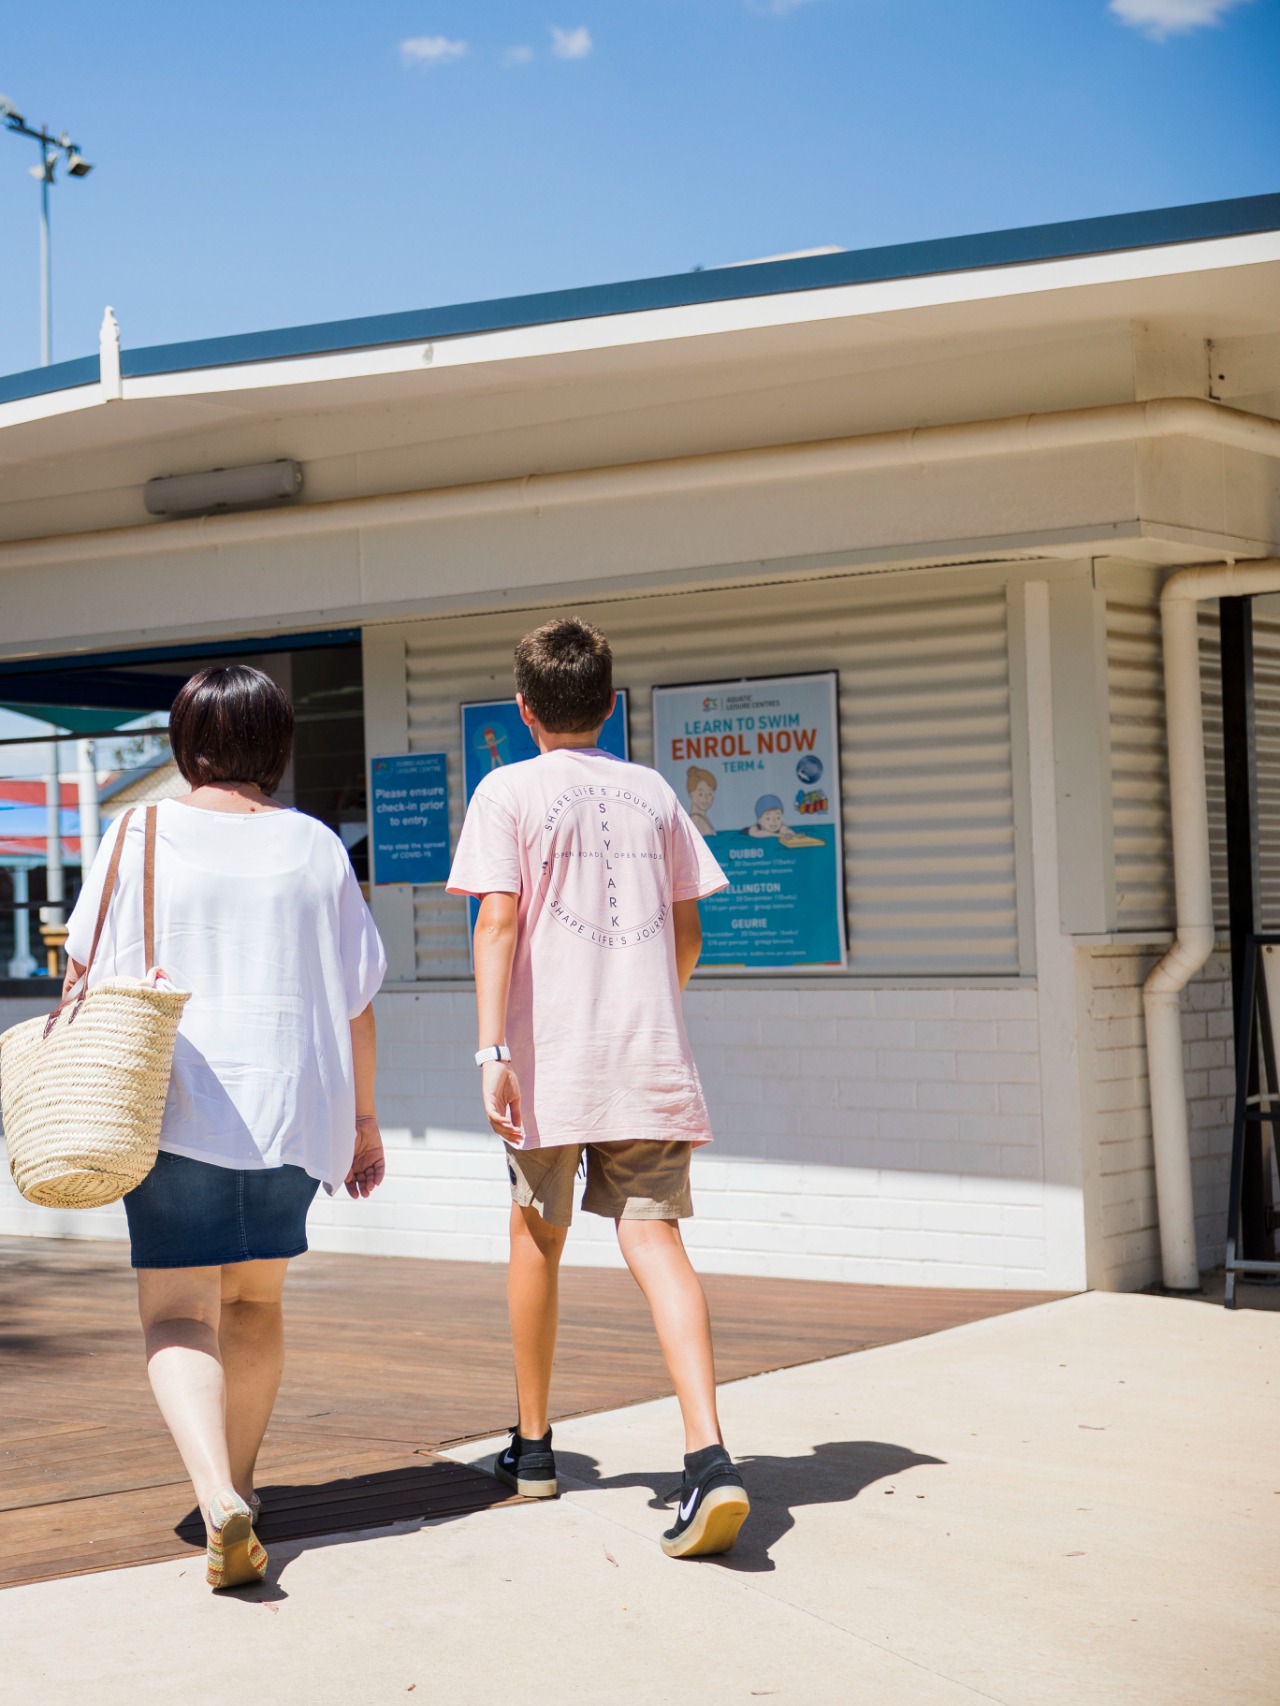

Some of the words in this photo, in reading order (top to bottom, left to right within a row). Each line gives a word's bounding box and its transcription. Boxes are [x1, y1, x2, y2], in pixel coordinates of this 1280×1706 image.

[685, 719, 733, 735] LEARN
[736, 717, 754, 731] TO
[758, 713, 800, 730] SWIM
[672, 733, 751, 761] ENROL
[758, 728, 817, 754] NOW
[722, 760, 754, 772] TERM
[758, 759, 764, 770] 4
[375, 788, 407, 798] Please
[410, 787, 444, 796] ensure
[376, 802, 418, 813] check-in
[420, 800, 444, 812] prior
[544, 794, 571, 831] SHAPE
[390, 818, 400, 826] to
[402, 816, 428, 826] entry
[729, 848, 764, 859] DUBBO
[599, 803, 620, 927] SKYLARK
[550, 900, 585, 934] SHAPE
[592, 932, 626, 946] LIFE'S
[636, 902, 666, 941] JOURNY
[731, 918, 768, 928] GEURIE
